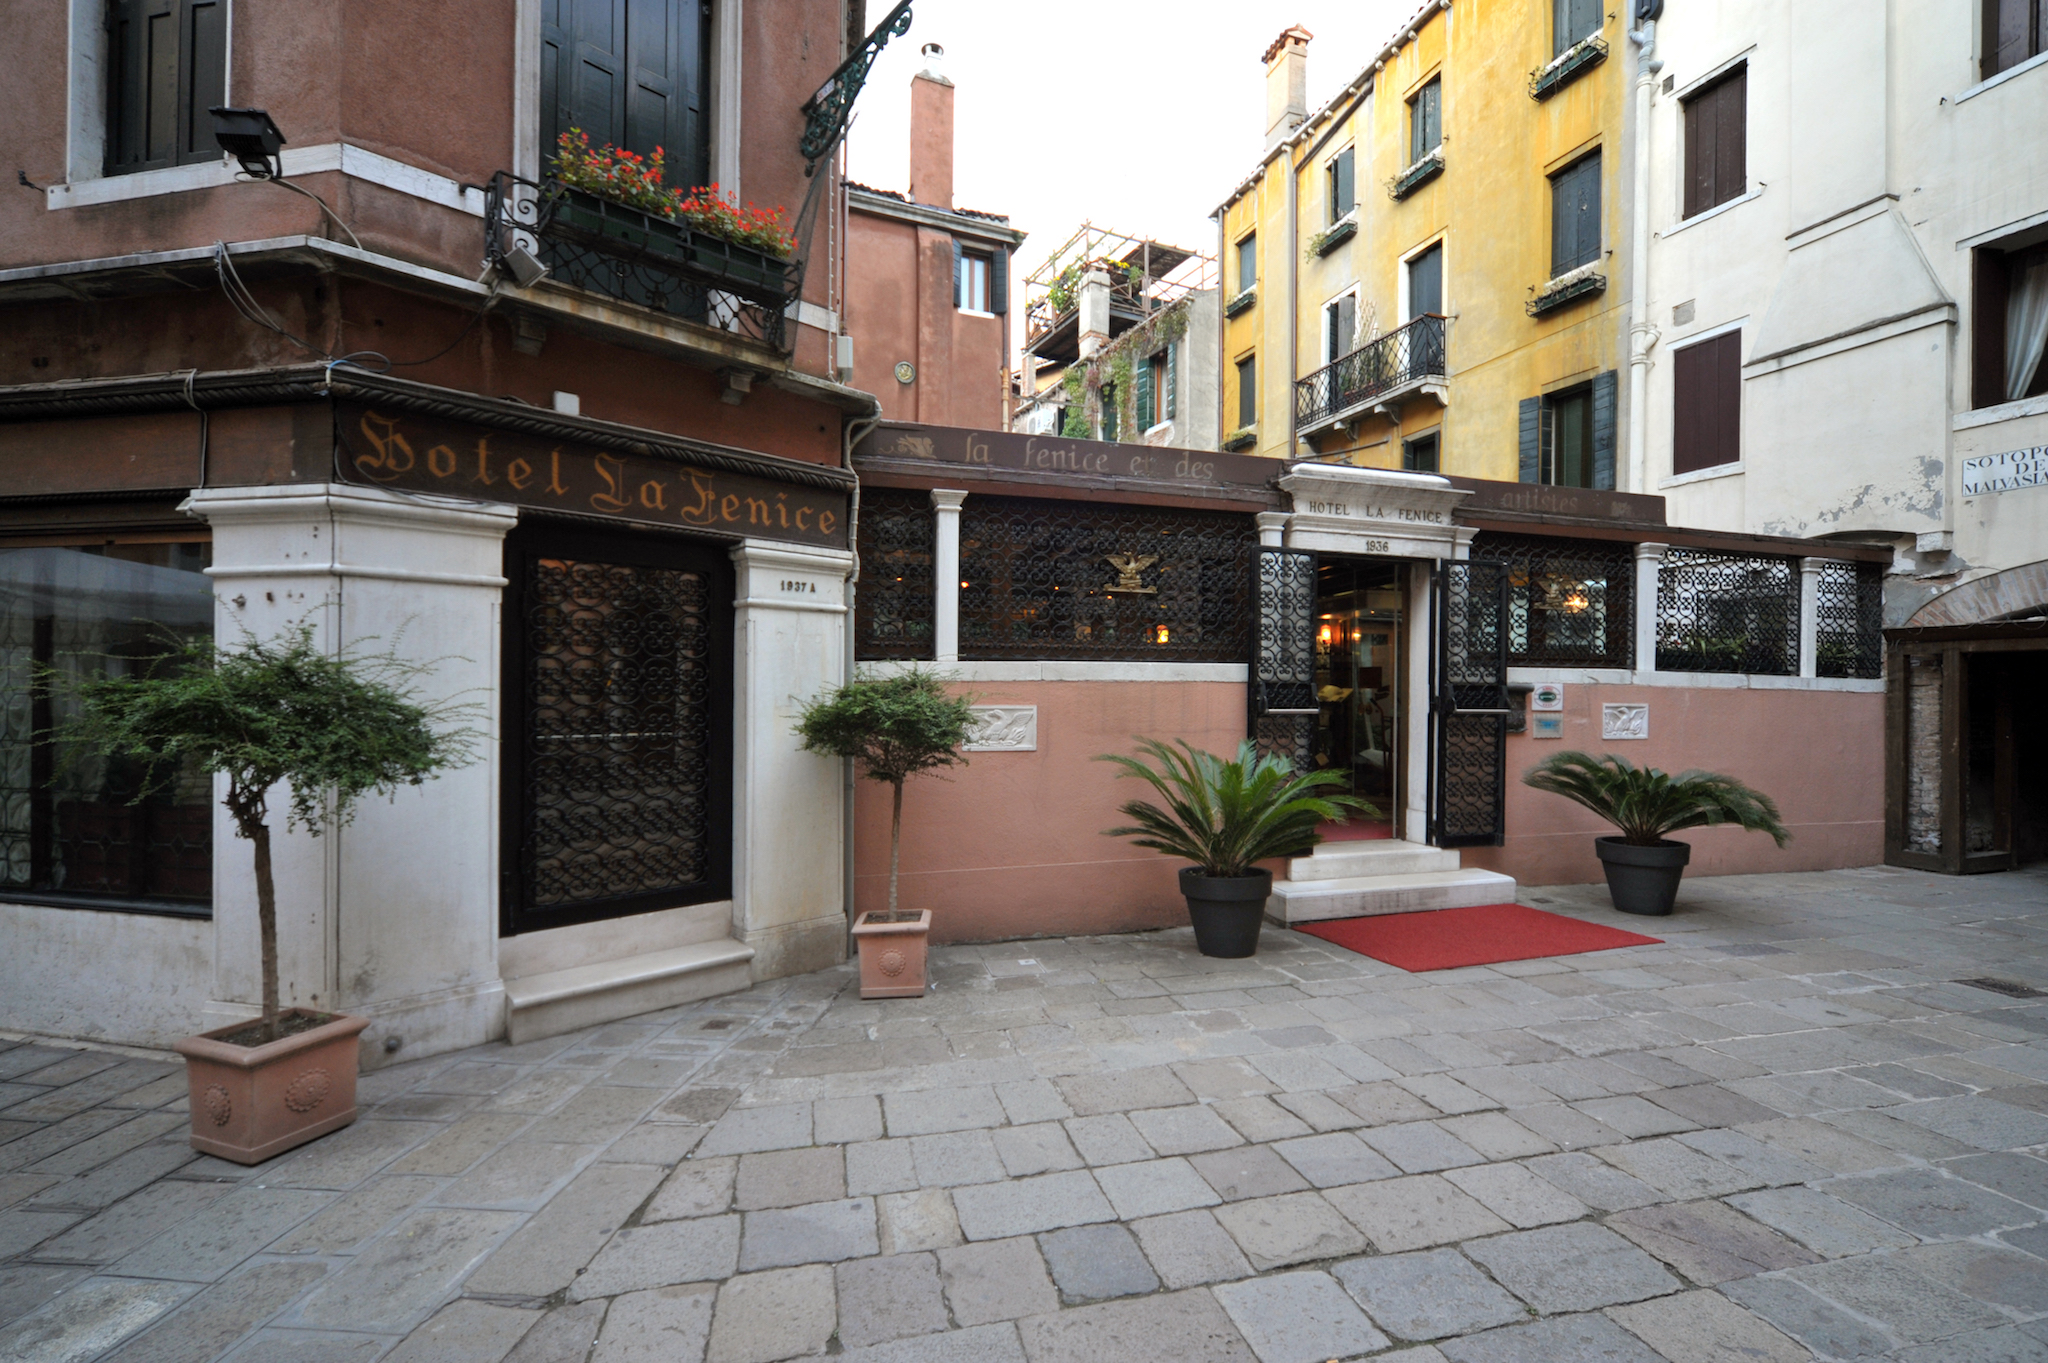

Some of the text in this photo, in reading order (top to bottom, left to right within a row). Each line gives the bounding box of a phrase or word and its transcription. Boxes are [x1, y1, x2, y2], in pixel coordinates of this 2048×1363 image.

[965, 433, 993, 464] la
[1175, 451, 1214, 480] des
[2016, 459, 2045, 475] DE
[355, 410, 836, 535] Hotel La Fenice
[1502, 487, 1578, 512] artistes
[1309, 501, 1442, 523] HOTEL LA FENICE
[1365, 539, 1389, 552] 1936
[780, 580, 806, 592] 1937
